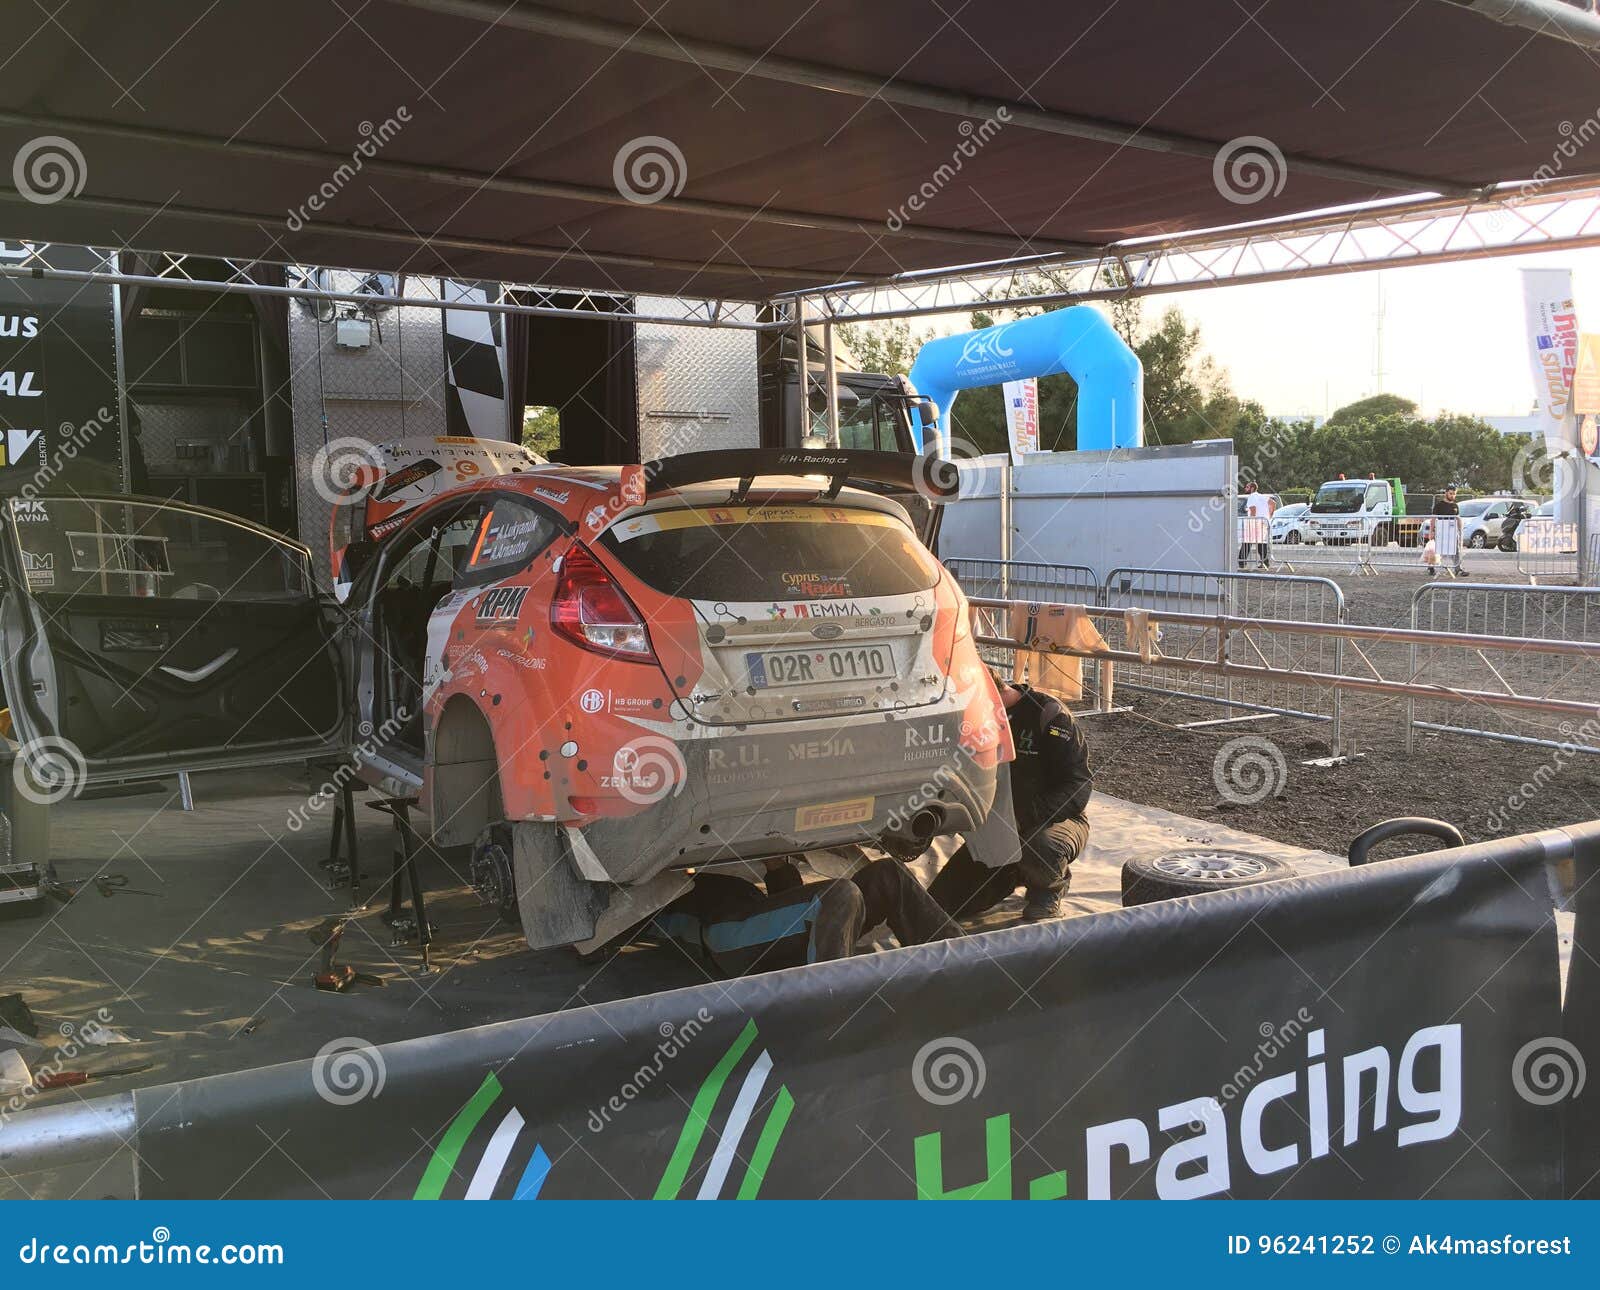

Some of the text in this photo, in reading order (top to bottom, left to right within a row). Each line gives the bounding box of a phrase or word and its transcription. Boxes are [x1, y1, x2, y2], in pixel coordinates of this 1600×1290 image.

[39, 435, 48, 466] ELEKTRA
[781, 572, 820, 586] Cyprus
[477, 586, 531, 618] RPM
[810, 602, 862, 618] EMMA
[855, 616, 896, 628] BERGASTO
[769, 649, 884, 682] 02R 0110
[905, 724, 951, 747] R.U.
[708, 744, 770, 770] R.U.
